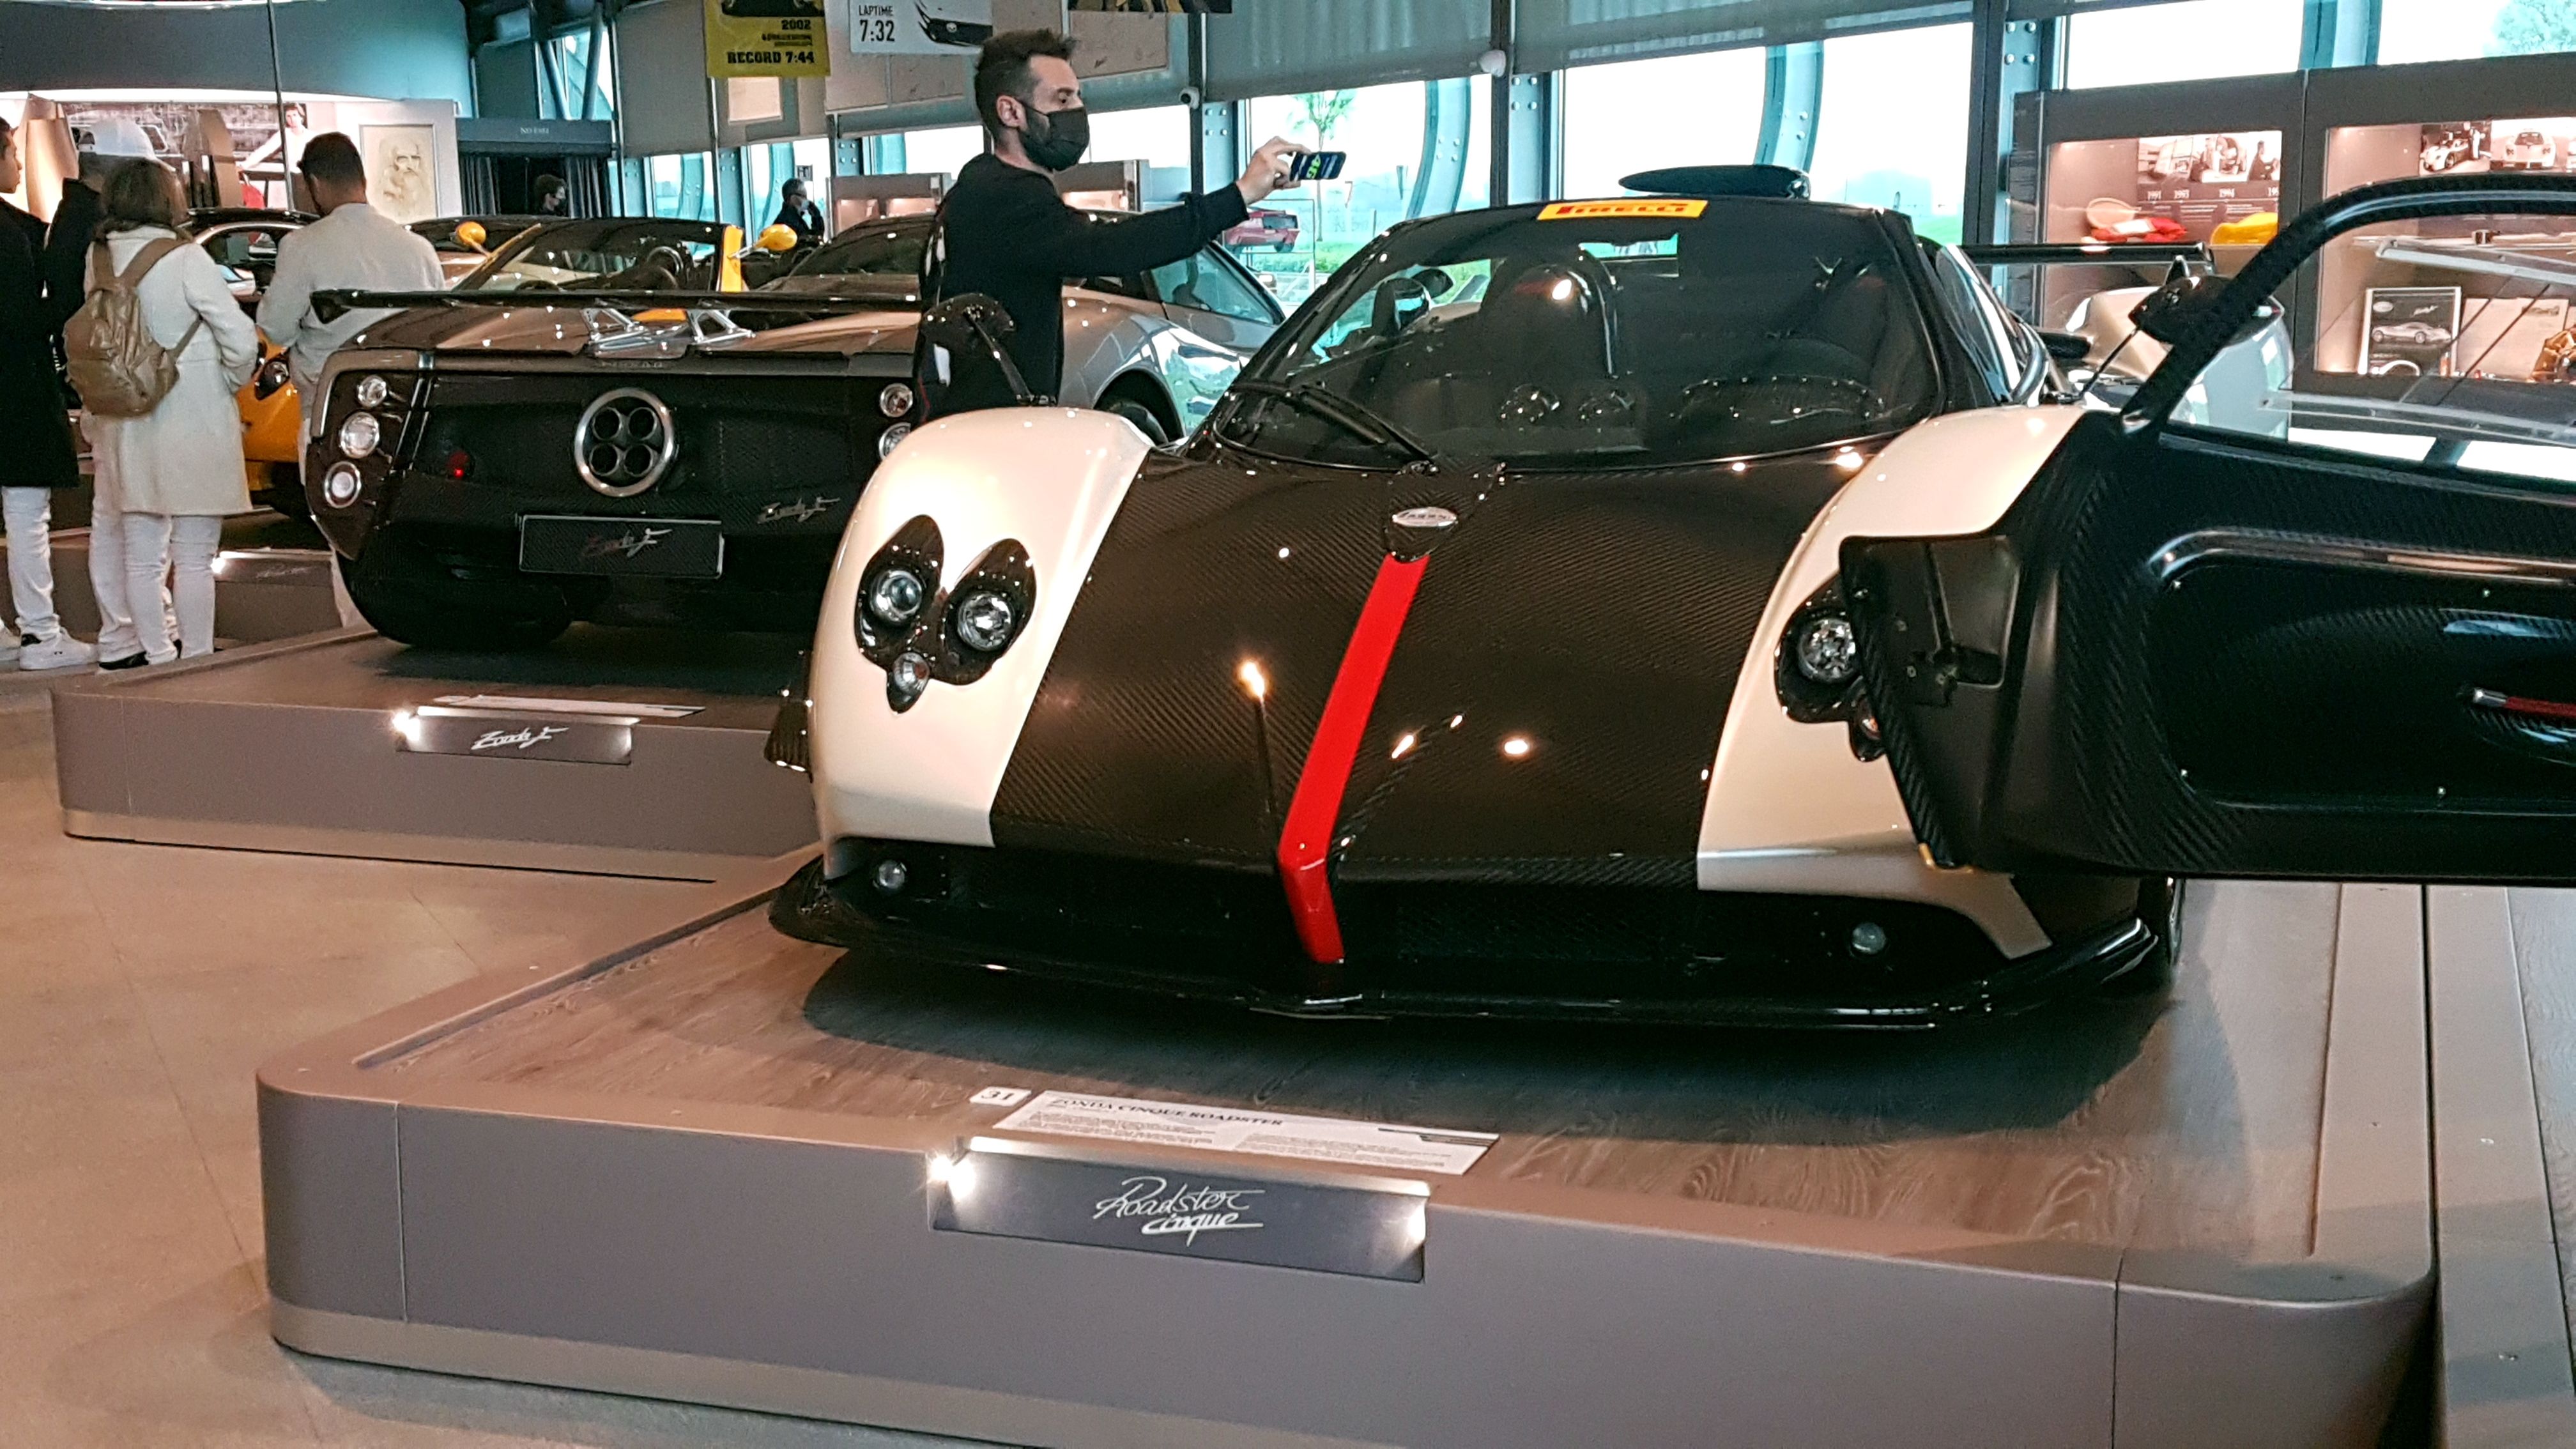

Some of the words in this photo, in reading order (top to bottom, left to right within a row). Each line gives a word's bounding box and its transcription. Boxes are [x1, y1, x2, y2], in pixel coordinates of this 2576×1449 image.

[859, 5, 893, 16] LAPTIME
[781, 20, 811, 30] 2002
[859, 19, 895, 42] 7:32
[727, 51, 781, 64] RECORD
[785, 51, 815, 63] 7:44
[981, 1091, 1015, 1100] 31
[1048, 1098, 1113, 1110] ZONDA
[1118, 1105, 1185, 1117] CINQUE
[1189, 1111, 1284, 1126] ROADSTER
[1092, 1176, 1266, 1220] Roadster
[1141, 1213, 1264, 1247] cinque
